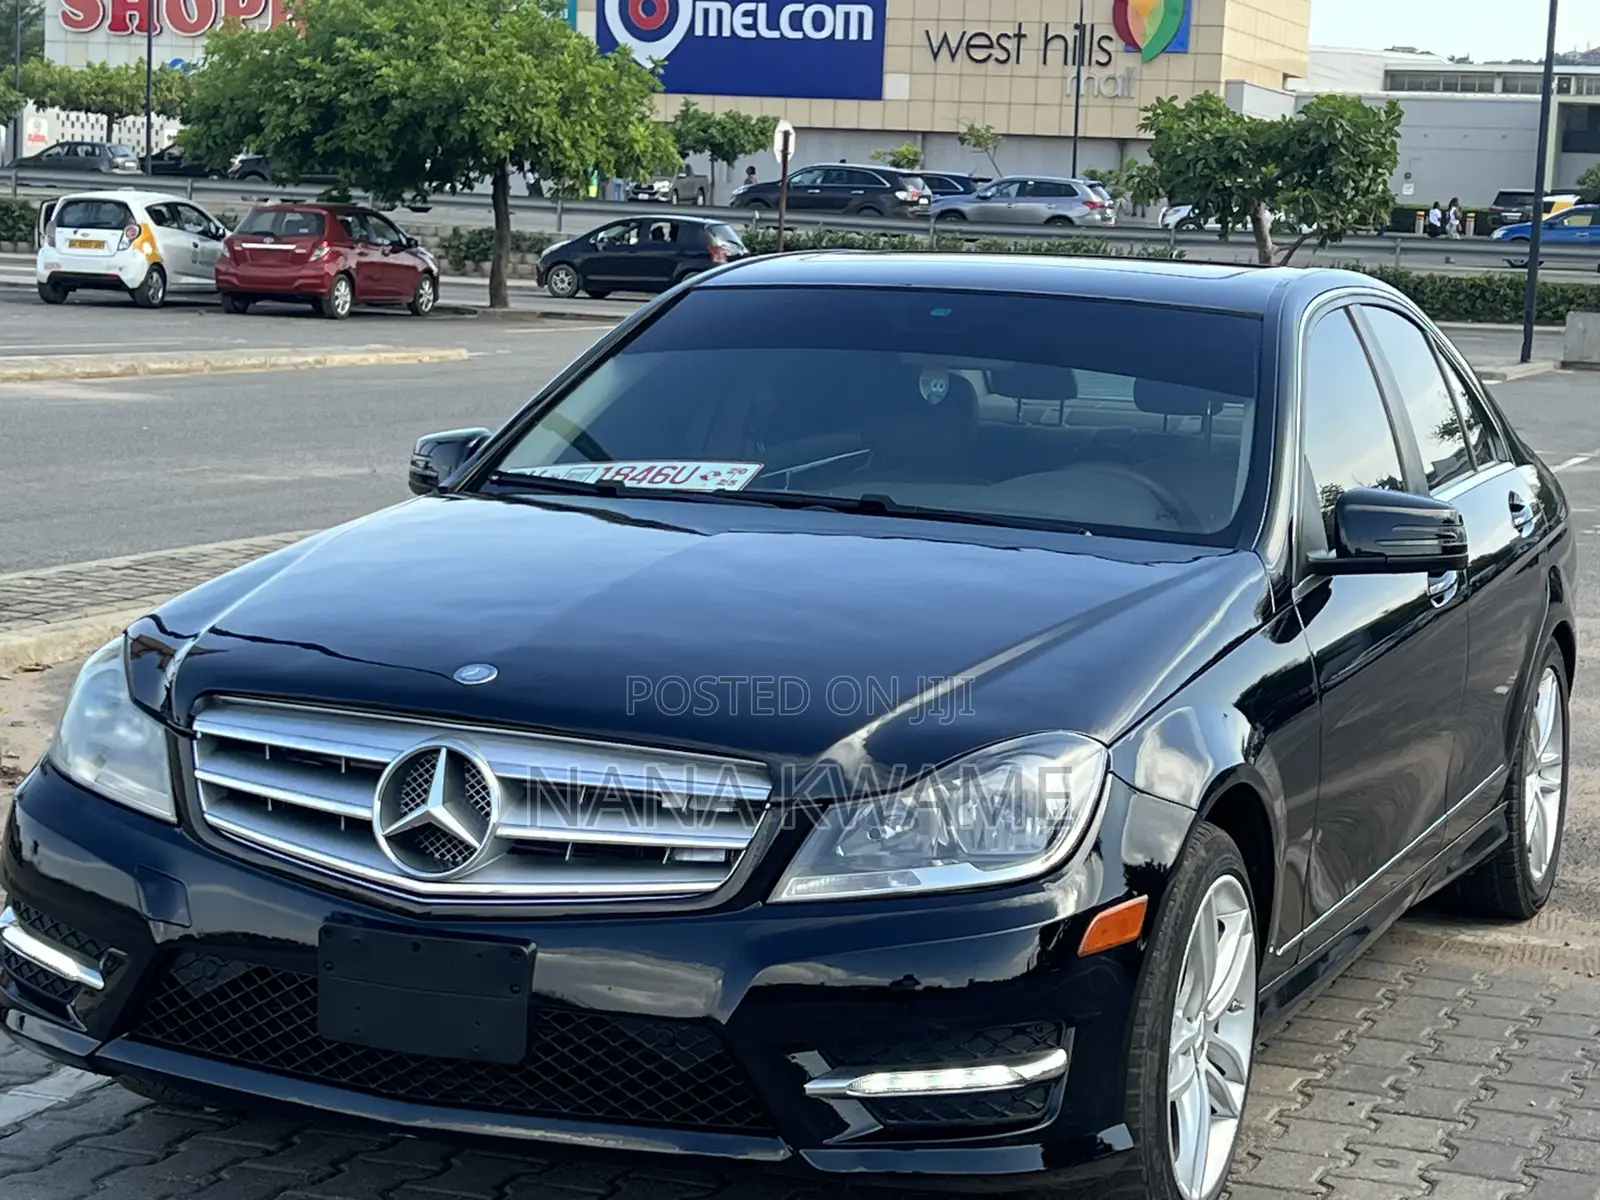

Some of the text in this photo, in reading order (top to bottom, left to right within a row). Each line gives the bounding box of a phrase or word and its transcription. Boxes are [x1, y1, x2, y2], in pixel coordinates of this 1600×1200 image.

[694, 1, 873, 41] MELCOM
[925, 22, 1114, 67] west hills
[1066, 66, 1137, 99] mall
[600, 466, 701, 485] 1846U
